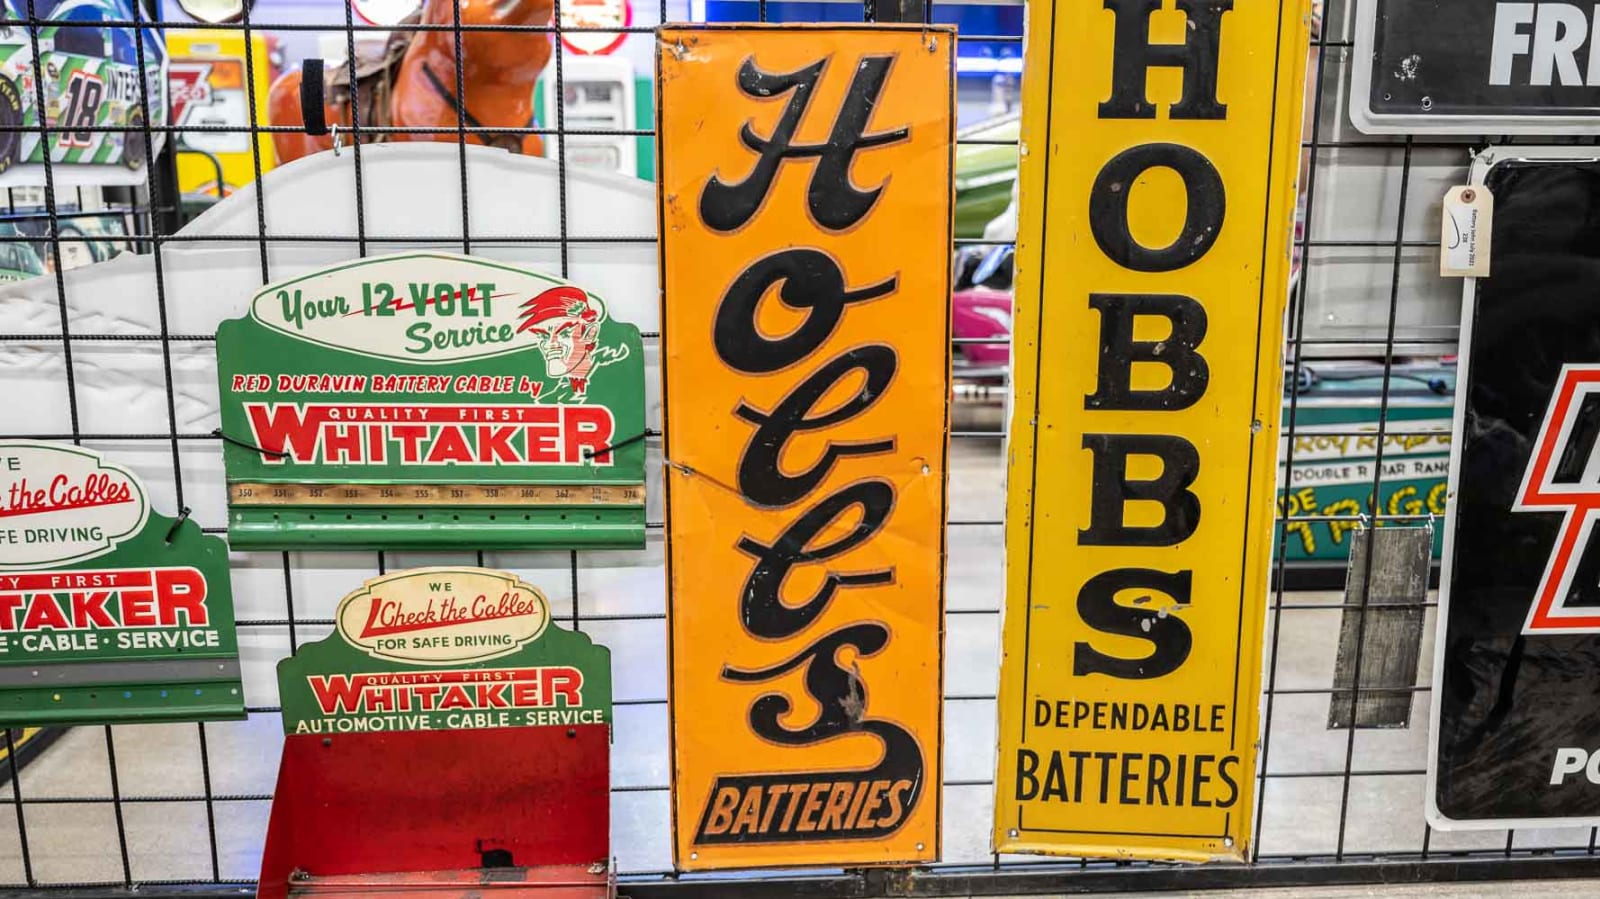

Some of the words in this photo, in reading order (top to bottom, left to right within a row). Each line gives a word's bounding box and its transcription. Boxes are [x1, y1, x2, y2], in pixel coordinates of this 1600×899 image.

[59, 68, 104, 147] 18
[277, 288, 350, 331] Your
[361, 282, 395, 317] 12
[408, 283, 496, 317] VOLT
[405, 322, 514, 354] Service
[1072, 0, 1233, 679] HOBBS
[232, 375, 272, 393] RED
[277, 375, 365, 393] DURAVIN
[372, 375, 451, 393] BATTERY
[454, 375, 513, 394] CABLE
[519, 375, 543, 398] by
[328, 407, 429, 421] QUALITY
[459, 407, 526, 421] FIRST
[242, 402, 615, 466] WHITAKER
[0, 457, 21, 471] E
[1293, 465, 1351, 482] DOUBLE
[8, 478, 46, 508] the
[50, 473, 132, 505] Cables
[238, 489, 253, 498] 350
[25, 527, 103, 543] DRIVING
[51, 574, 118, 588] FIRST
[429, 582, 452, 592] WE
[380, 598, 437, 626] Check
[440, 598, 467, 621] the
[471, 592, 534, 618] Cables
[22, 633, 99, 652] CABLE
[117, 630, 220, 649] SERVICE
[377, 638, 407, 651] FOR
[413, 636, 450, 649] SAFE
[454, 634, 512, 648] DRIVING
[307, 666, 584, 716] WHITAKER
[367, 673, 443, 686] QUALITY
[462, 671, 516, 683] FIRST
[295, 716, 430, 734] AUTOMOTIVE
[447, 712, 510, 729] CABLE
[526, 709, 604, 726] SERVICE
[1034, 700, 1226, 733] DEPENDABLE
[1015, 748, 1240, 809] BATTERIES
[704, 776, 913, 835] BATTERIES
